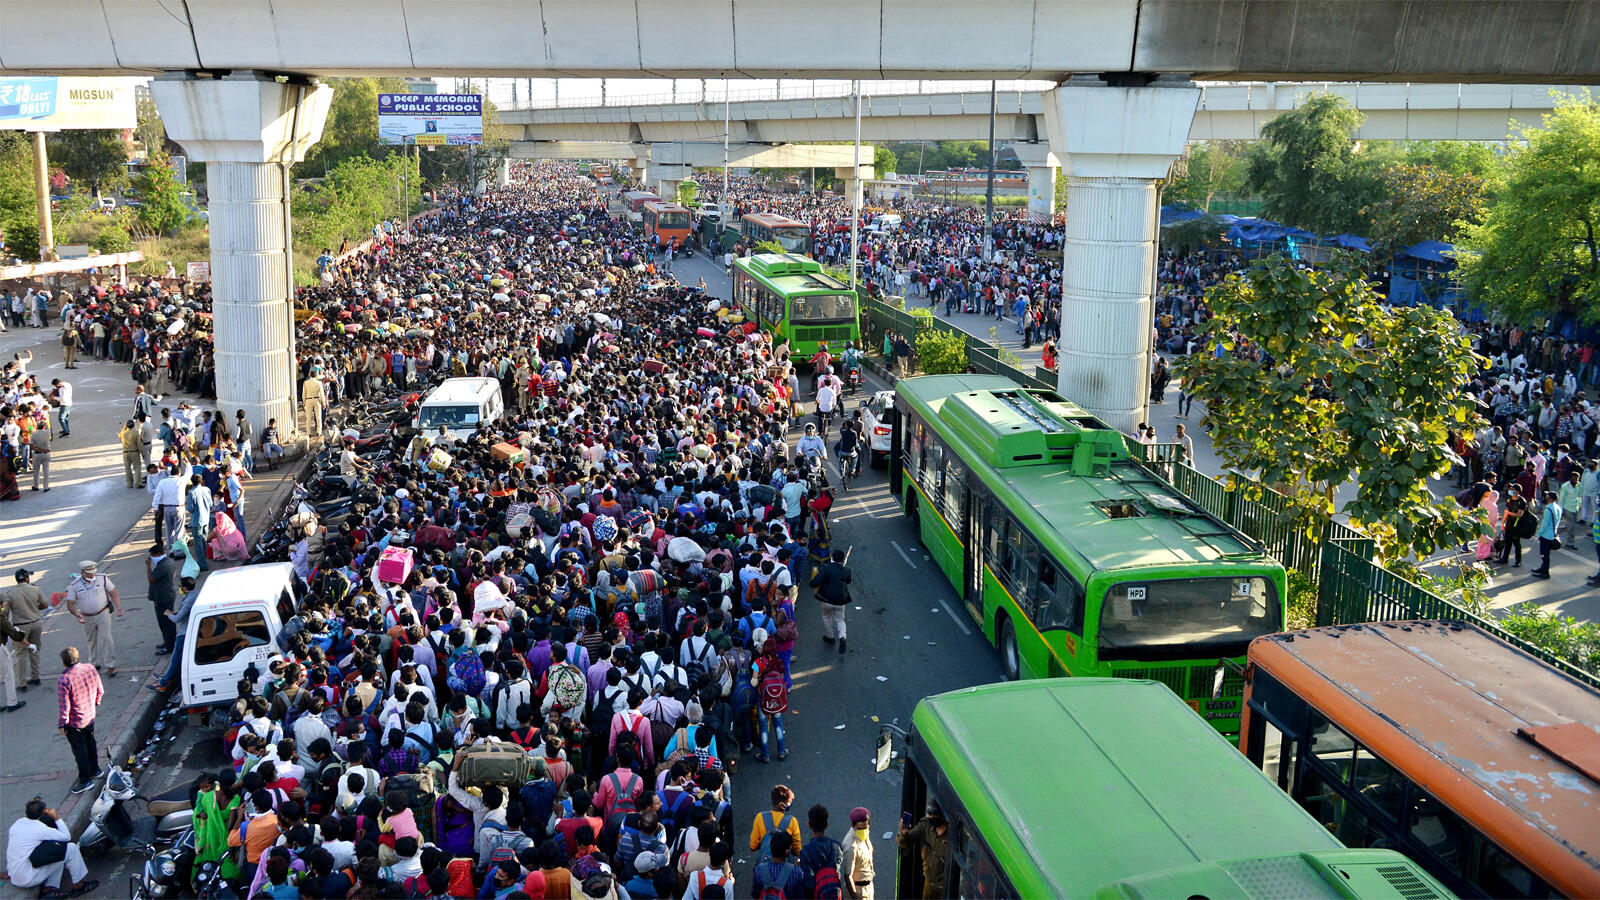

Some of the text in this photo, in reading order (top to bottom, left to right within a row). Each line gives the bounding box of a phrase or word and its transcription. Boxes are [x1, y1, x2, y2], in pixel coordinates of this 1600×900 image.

[69, 89, 114, 100] MIGSUN
[393, 95, 479, 103] DEEP MEMORIAL
[1242, 585, 1247, 593] E
[1129, 589, 1144, 598] HPD
[1207, 701, 1235, 709] TATA
